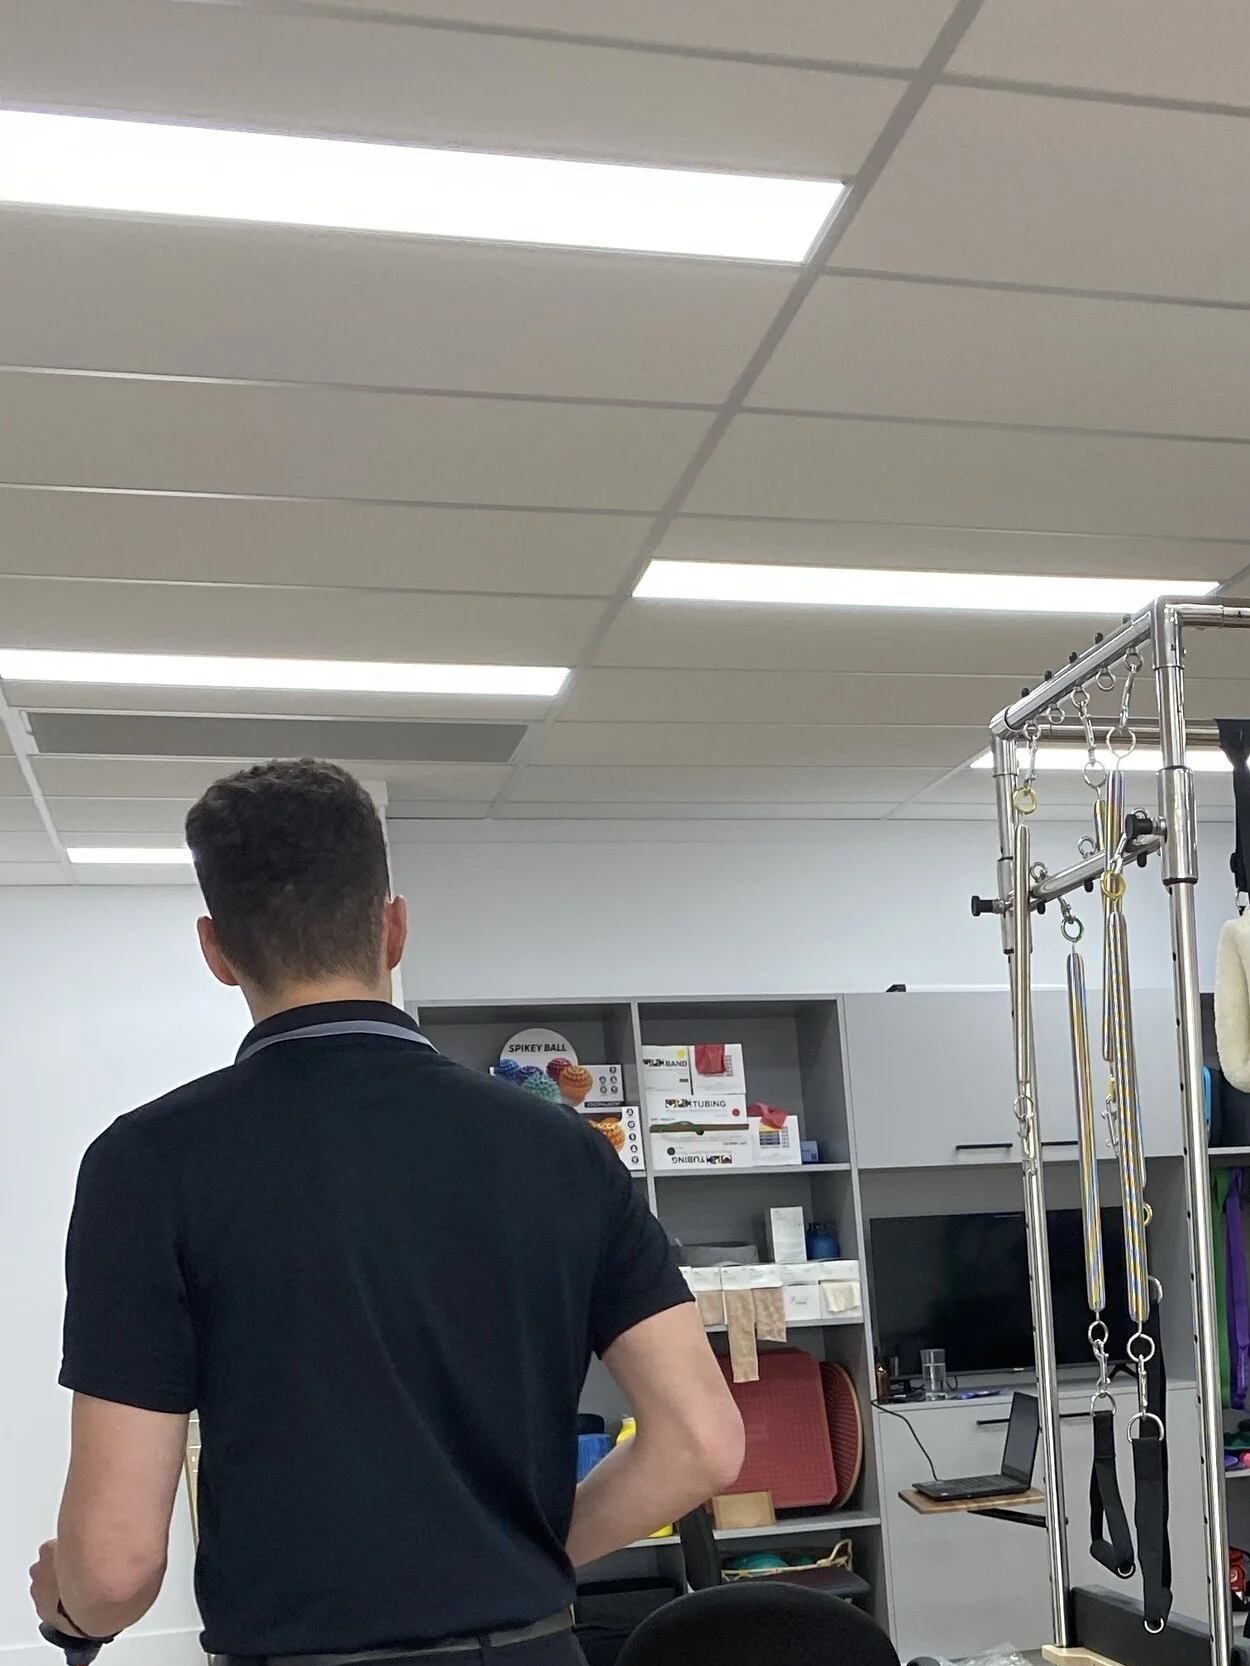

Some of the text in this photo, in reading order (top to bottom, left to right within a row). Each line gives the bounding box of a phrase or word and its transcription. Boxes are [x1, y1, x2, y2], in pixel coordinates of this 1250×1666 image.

[508, 1043, 567, 1053] SPIKEY BALL
[693, 1100, 726, 1108] TUBING
[671, 1156, 706, 1164] TUBING
